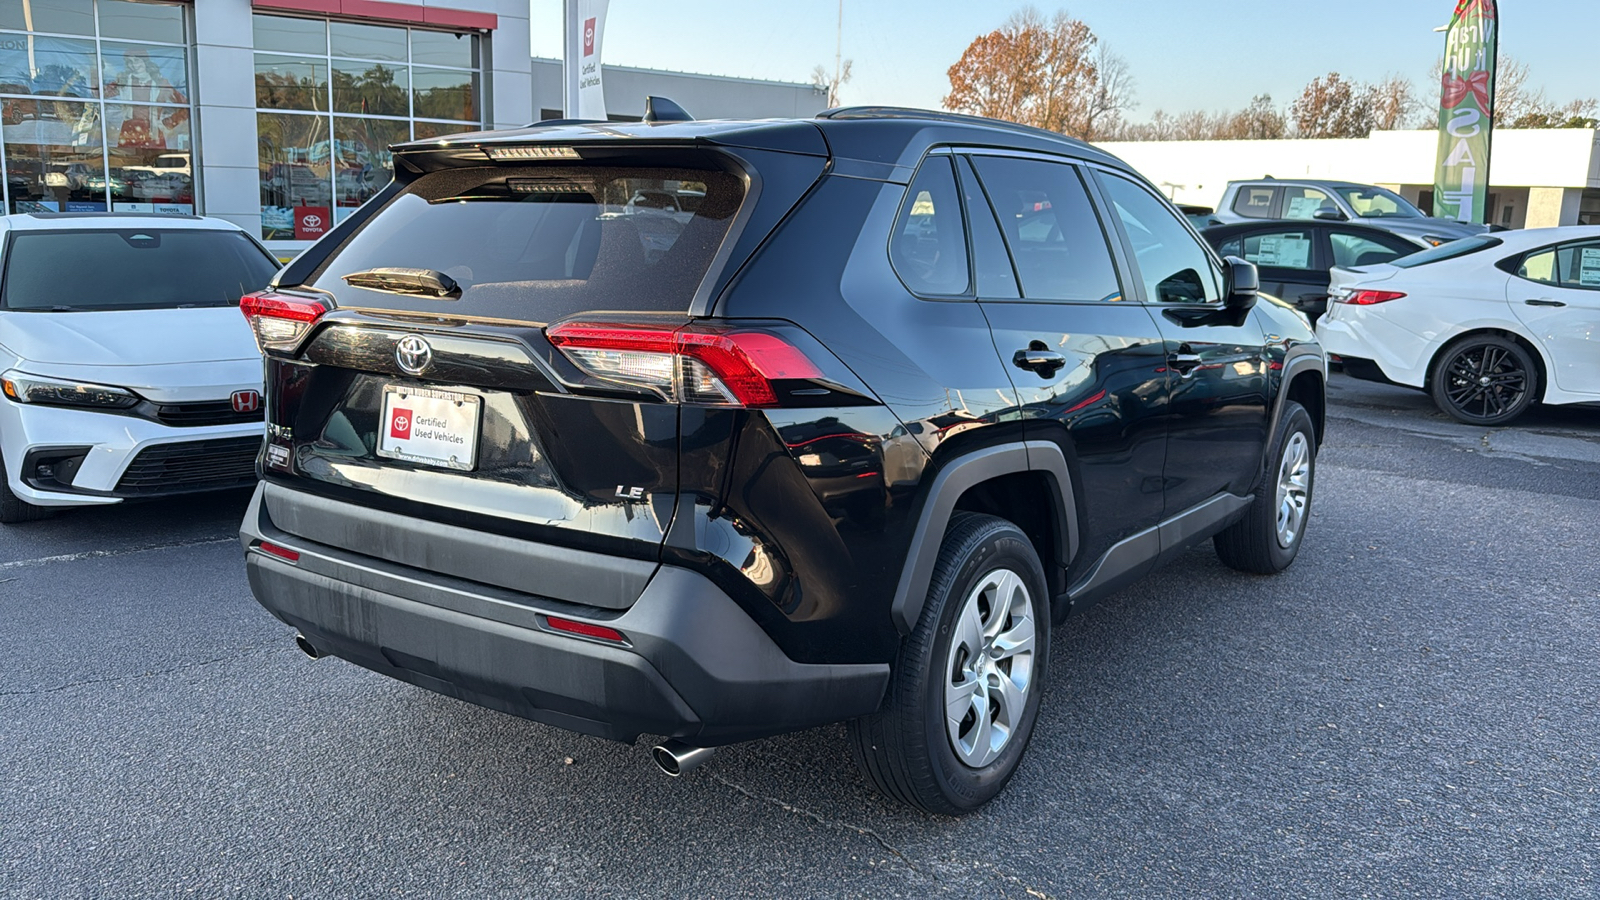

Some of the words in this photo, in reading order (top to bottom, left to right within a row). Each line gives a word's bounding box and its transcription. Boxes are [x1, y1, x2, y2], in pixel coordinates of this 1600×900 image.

[582, 62, 595, 75] Certified
[585, 75, 600, 86] Vehicles
[416, 415, 447, 428] Certified
[414, 428, 432, 439] Used
[434, 431, 464, 444] Vehicles
[614, 484, 644, 499] LE
